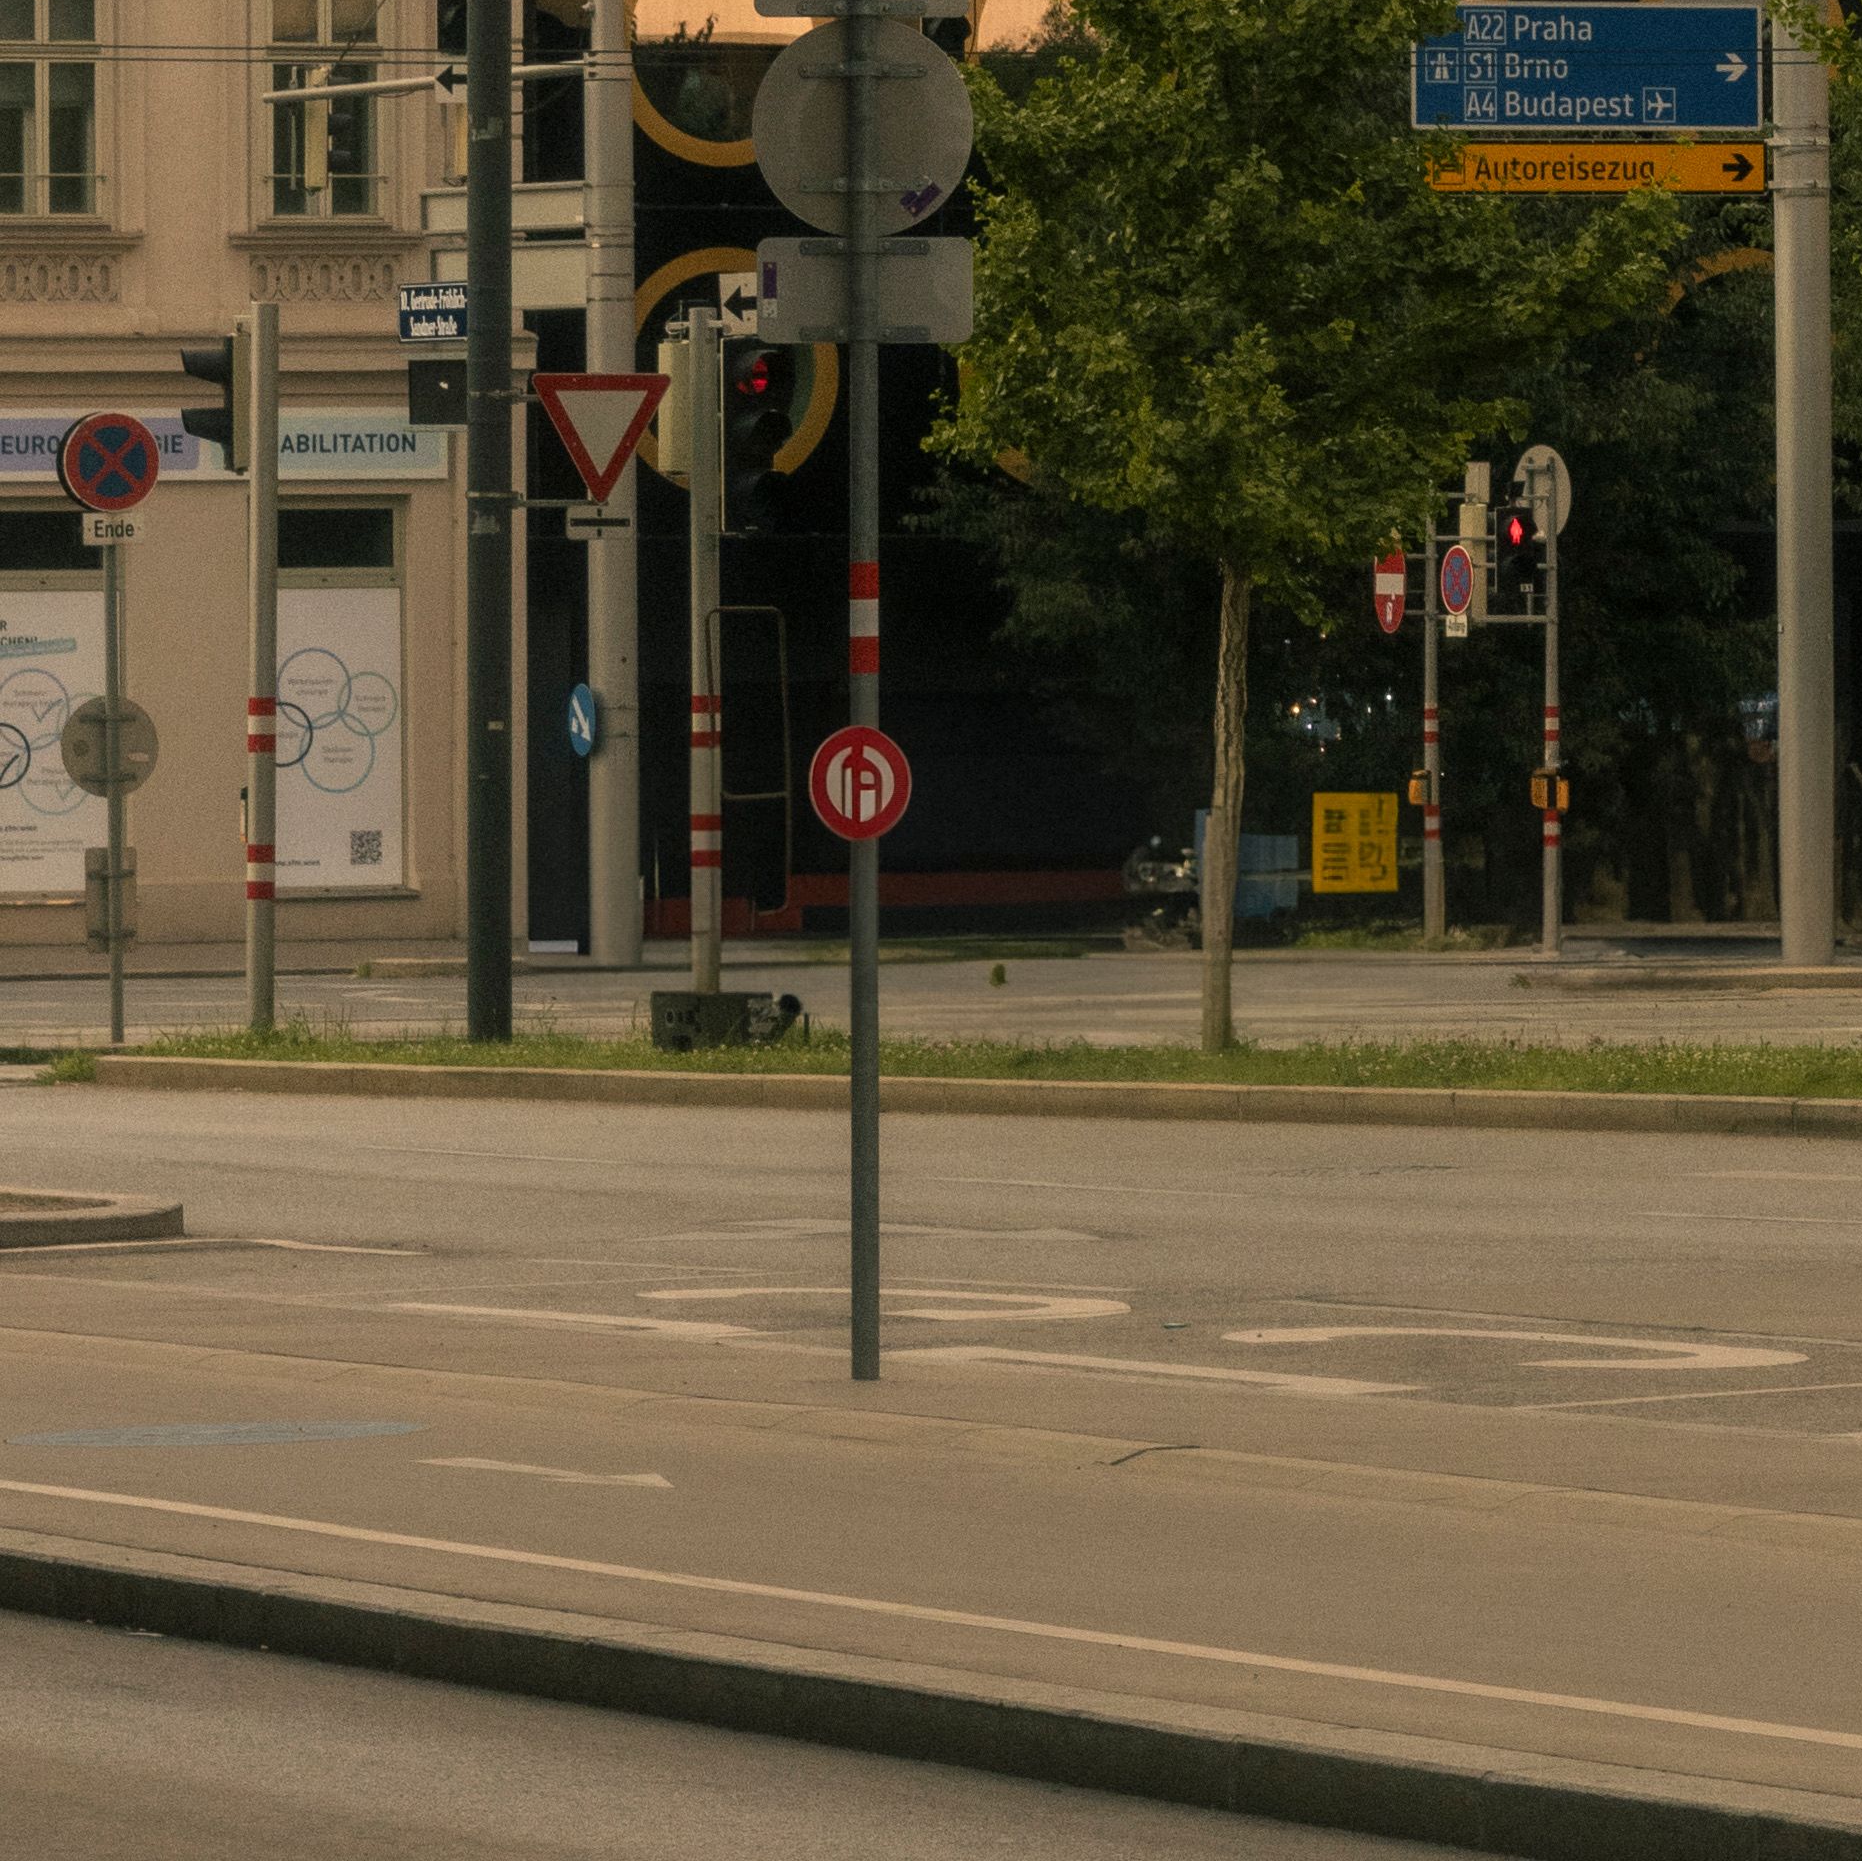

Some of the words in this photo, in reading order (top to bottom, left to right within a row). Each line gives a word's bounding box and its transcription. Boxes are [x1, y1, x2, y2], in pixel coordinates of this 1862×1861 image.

[1466, 15, 1504, 40] A22
[1515, 15, 1593, 41] Praha
[1469, 52, 1494, 79] S1
[1505, 52, 1568, 79] Brno
[1466, 92, 1495, 117] A4
[1505, 91, 1634, 123] Budapest
[1475, 153, 1655, 184] Autoreisezug
[95, 520, 134, 538] Ende
